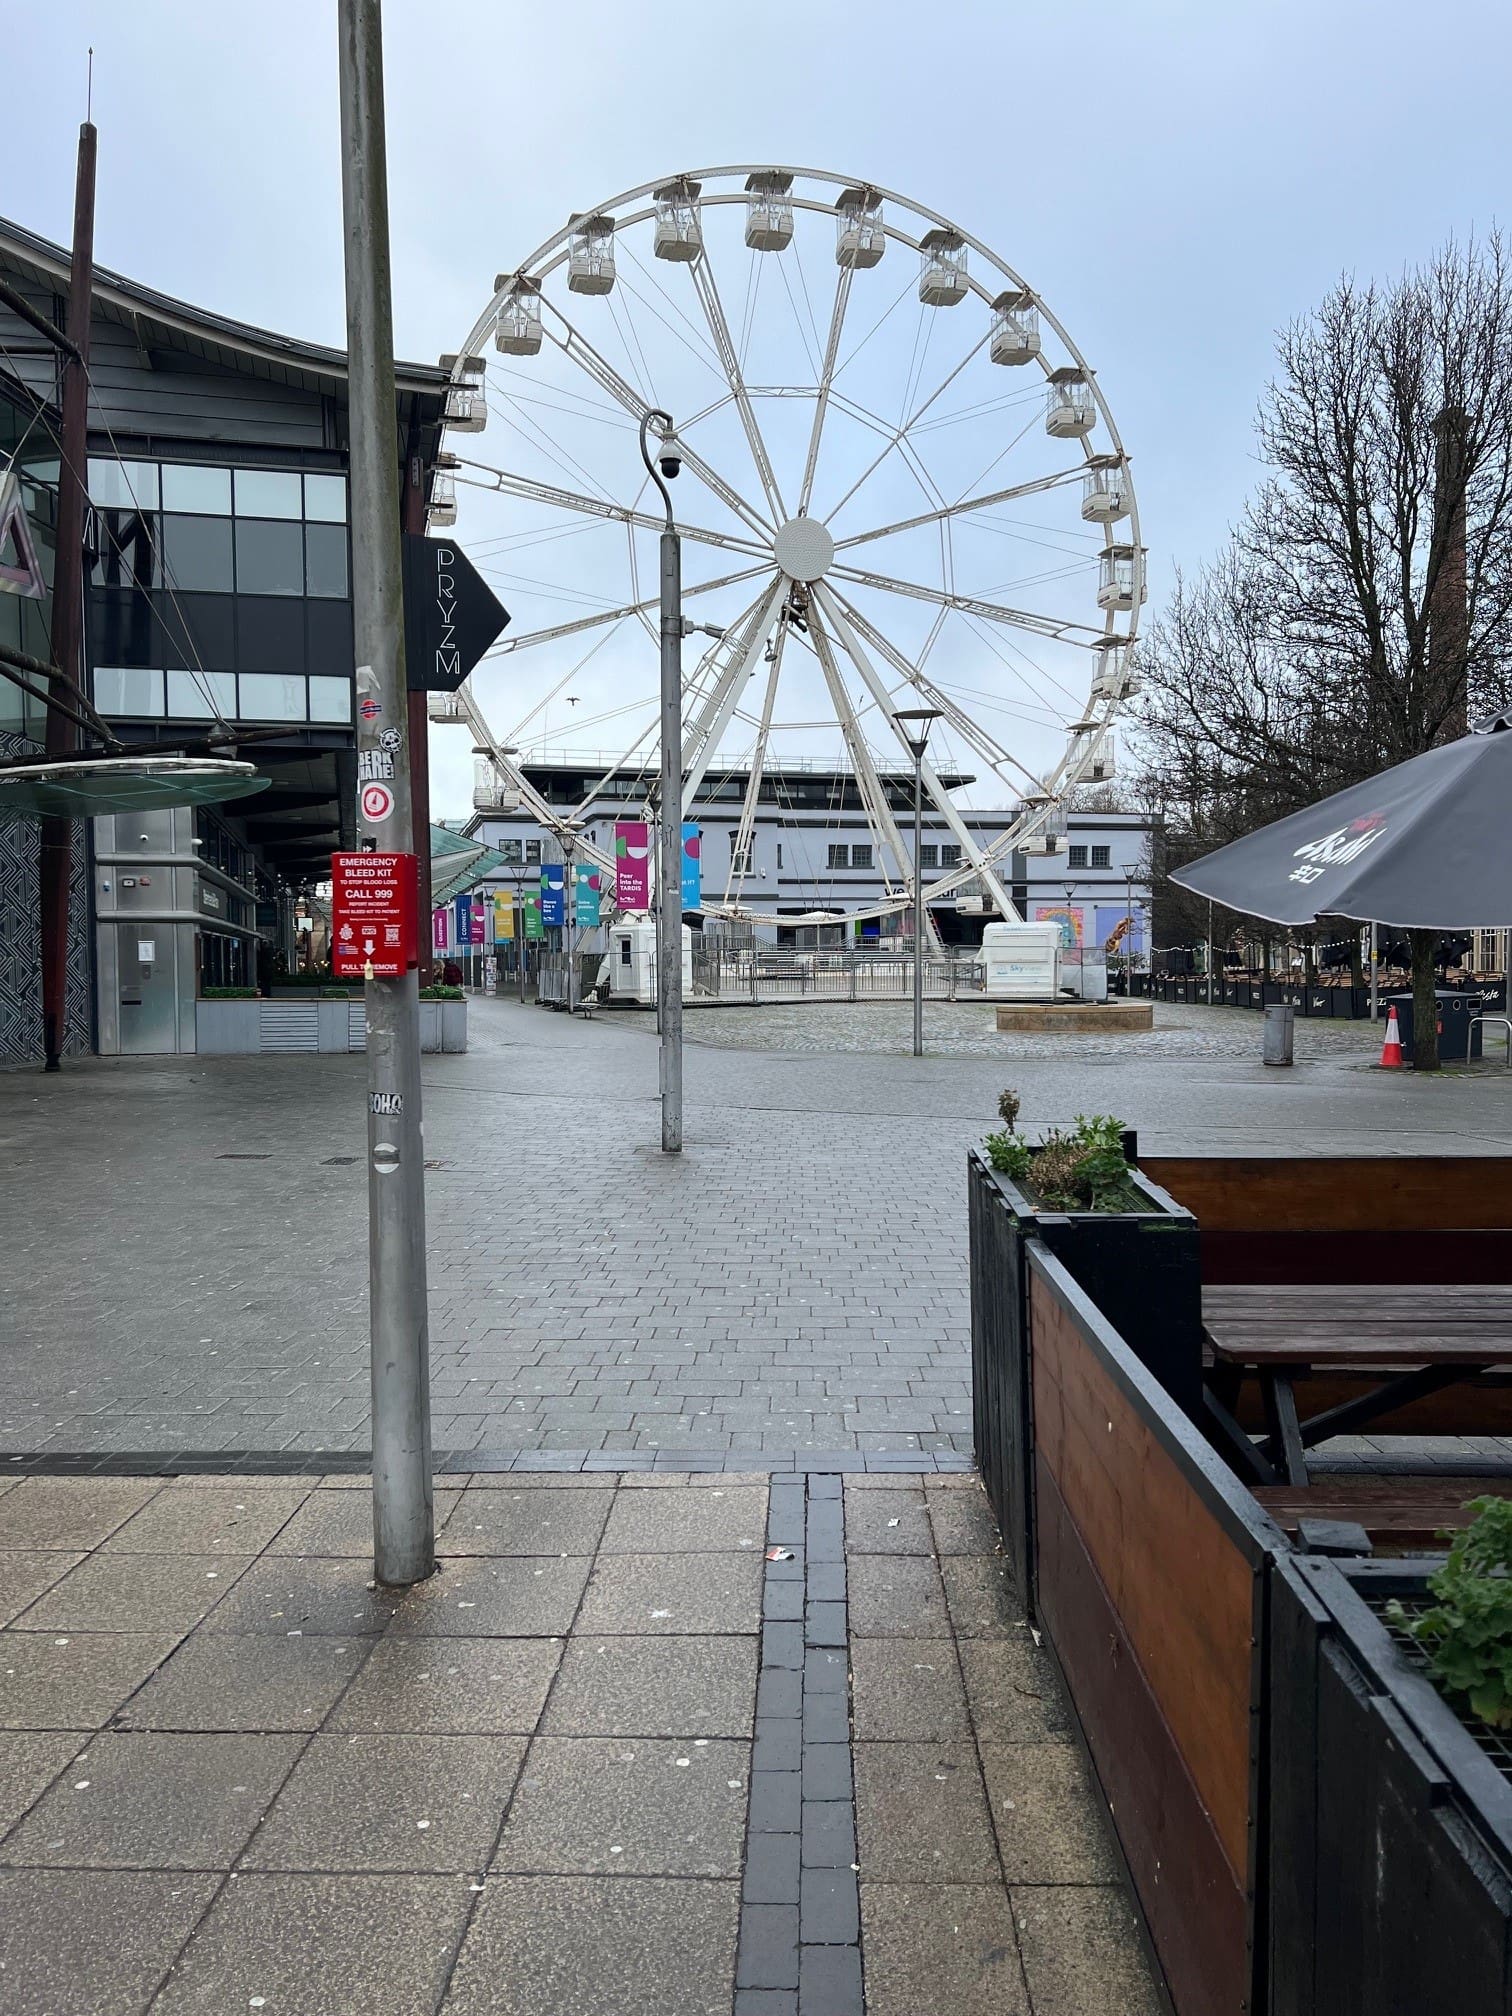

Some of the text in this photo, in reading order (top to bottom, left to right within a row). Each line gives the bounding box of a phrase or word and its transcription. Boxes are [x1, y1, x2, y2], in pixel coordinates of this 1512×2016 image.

[436, 548, 460, 675] PRYZM
[1292, 826, 1389, 865] Asahi
[339, 857, 398, 867] EMERGENCY
[345, 868, 392, 878] BLEED KIT
[345, 889, 393, 899] CALL 999
